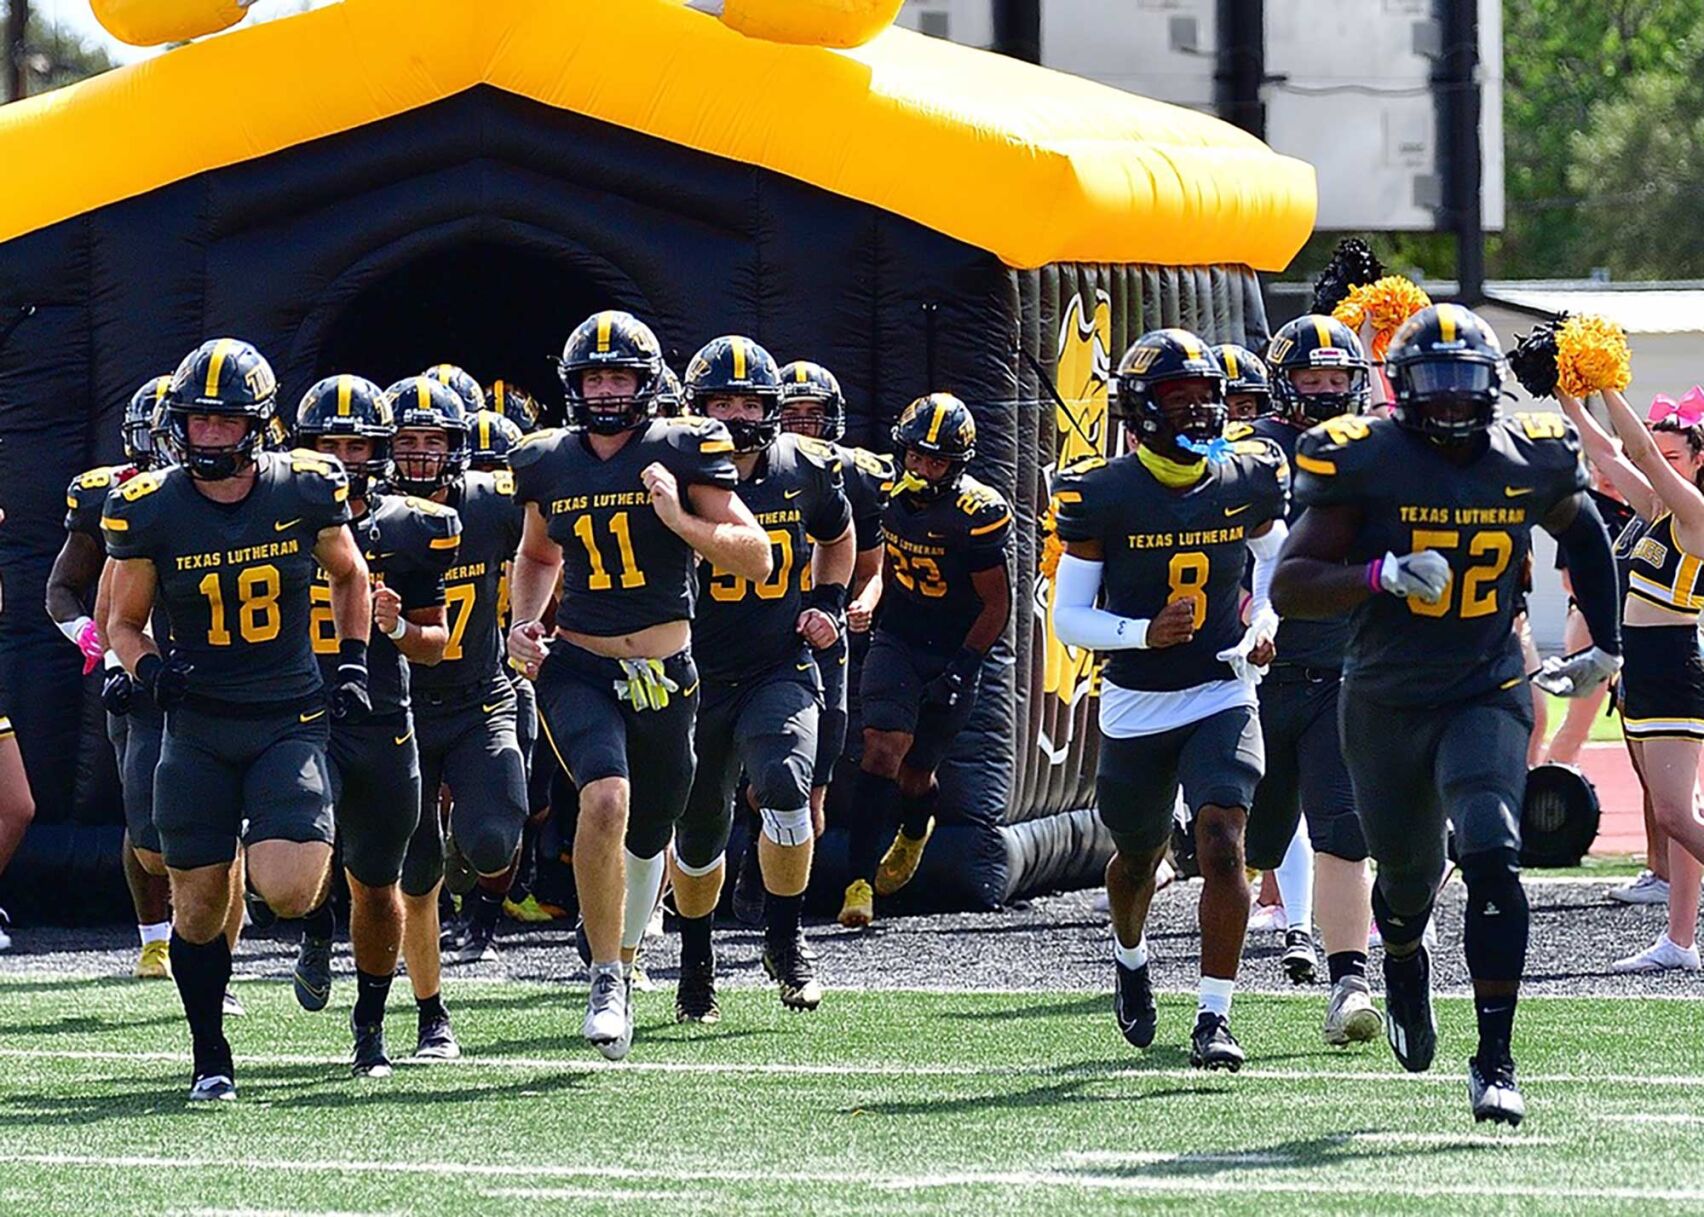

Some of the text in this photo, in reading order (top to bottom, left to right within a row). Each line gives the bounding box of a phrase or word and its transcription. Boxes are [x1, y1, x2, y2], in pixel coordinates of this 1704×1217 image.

[552, 492, 653, 515] TEXAS LUTHERA
[1400, 507, 1526, 524] TEXAS LUTHERAN
[755, 510, 801, 525] THERAN
[1128, 526, 1245, 549] TEXAS LUTHERAN
[176, 540, 299, 570] TEXAS LUTHERAN
[574, 512, 646, 590] 11
[444, 562, 485, 581] HERAN
[1407, 530, 1513, 618] 52
[1167, 551, 1210, 630] 8
[199, 563, 281, 645] 18
